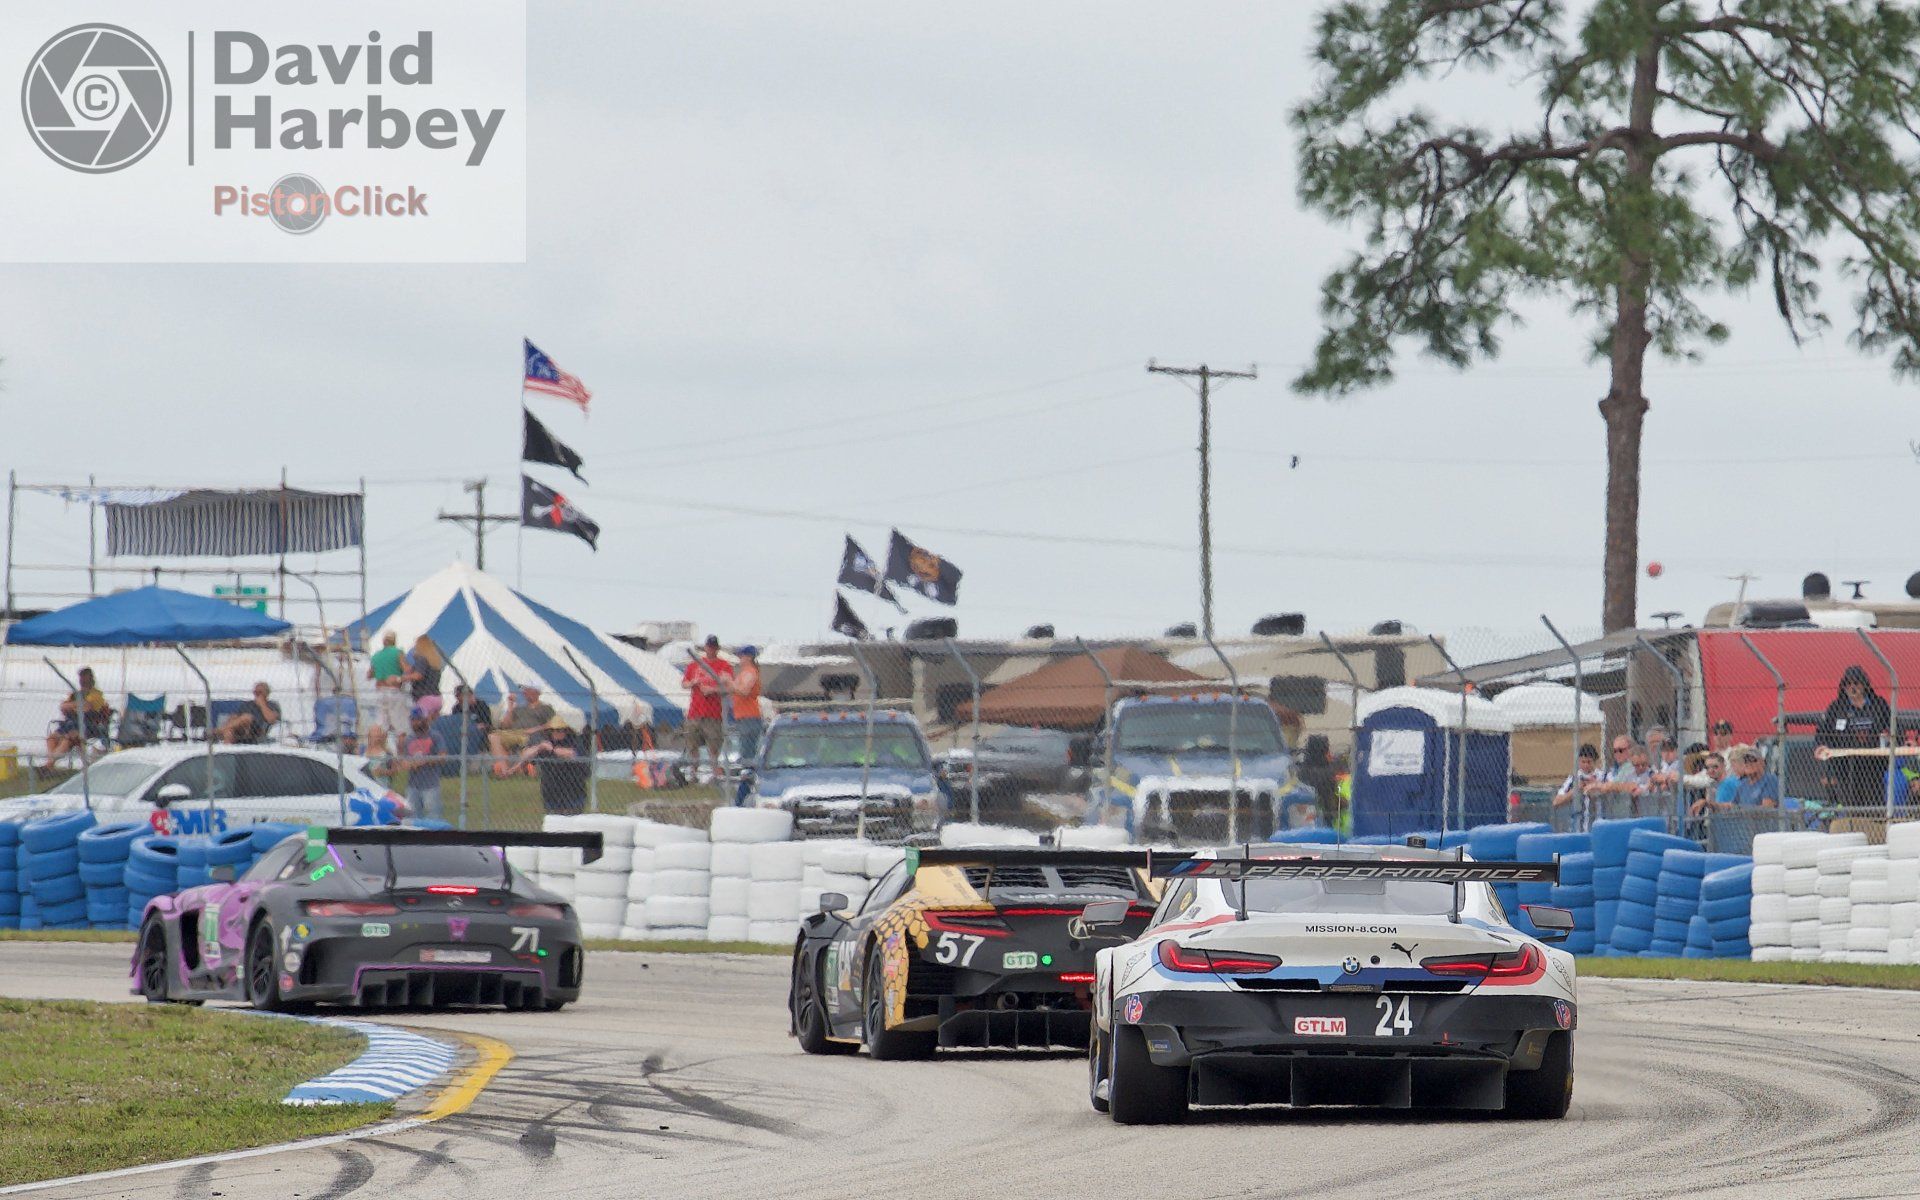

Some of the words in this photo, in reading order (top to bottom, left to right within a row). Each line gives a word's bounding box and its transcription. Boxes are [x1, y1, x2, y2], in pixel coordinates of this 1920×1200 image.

[1246, 865, 1542, 880] PERFORMANCE
[1305, 925, 1397, 934] MISSION-8.COM
[510, 926, 540, 953] 71
[935, 931, 986, 968] 57
[1006, 953, 1036, 966] GTD
[1375, 994, 1413, 1036] 24
[1297, 1020, 1345, 1033] GTLM
